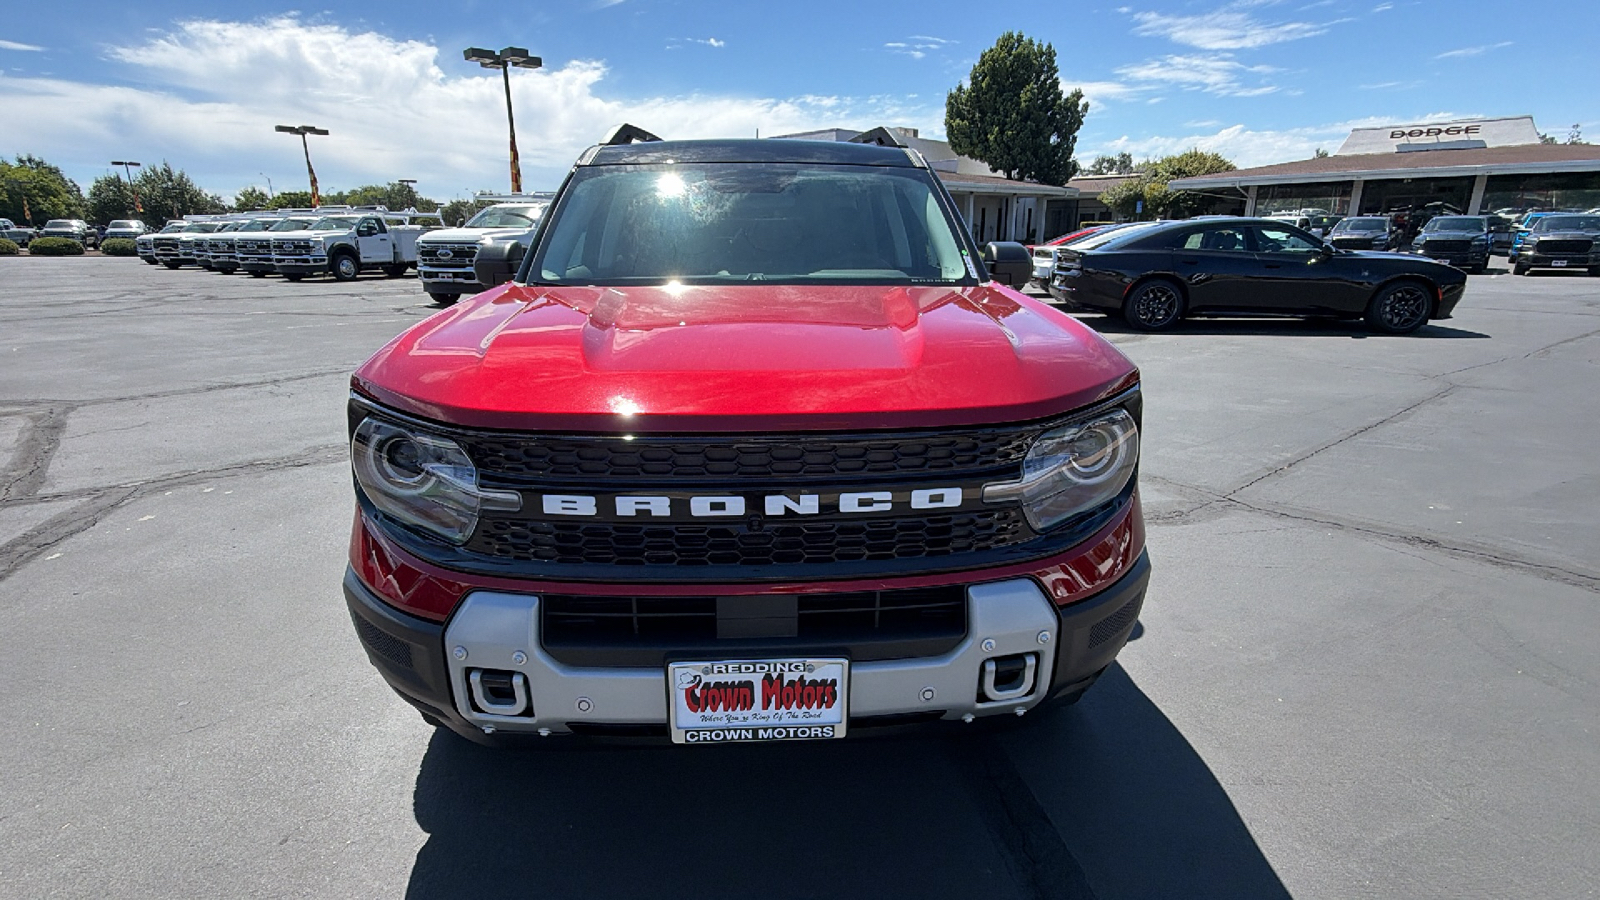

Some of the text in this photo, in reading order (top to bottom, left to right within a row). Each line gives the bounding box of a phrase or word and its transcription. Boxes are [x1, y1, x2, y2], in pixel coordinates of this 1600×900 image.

[1390, 125, 1482, 139] DODGE
[542, 487, 963, 517] BRONCO
[713, 663, 804, 674] REDDING
[685, 673, 838, 713] Crown Motors
[700, 713, 723, 722] Where
[751, 712, 770, 721] King
[773, 712, 783, 721] Of
[786, 711, 799, 719] The
[801, 711, 822, 719] Road
[686, 726, 834, 742] CROWN MOTORS
